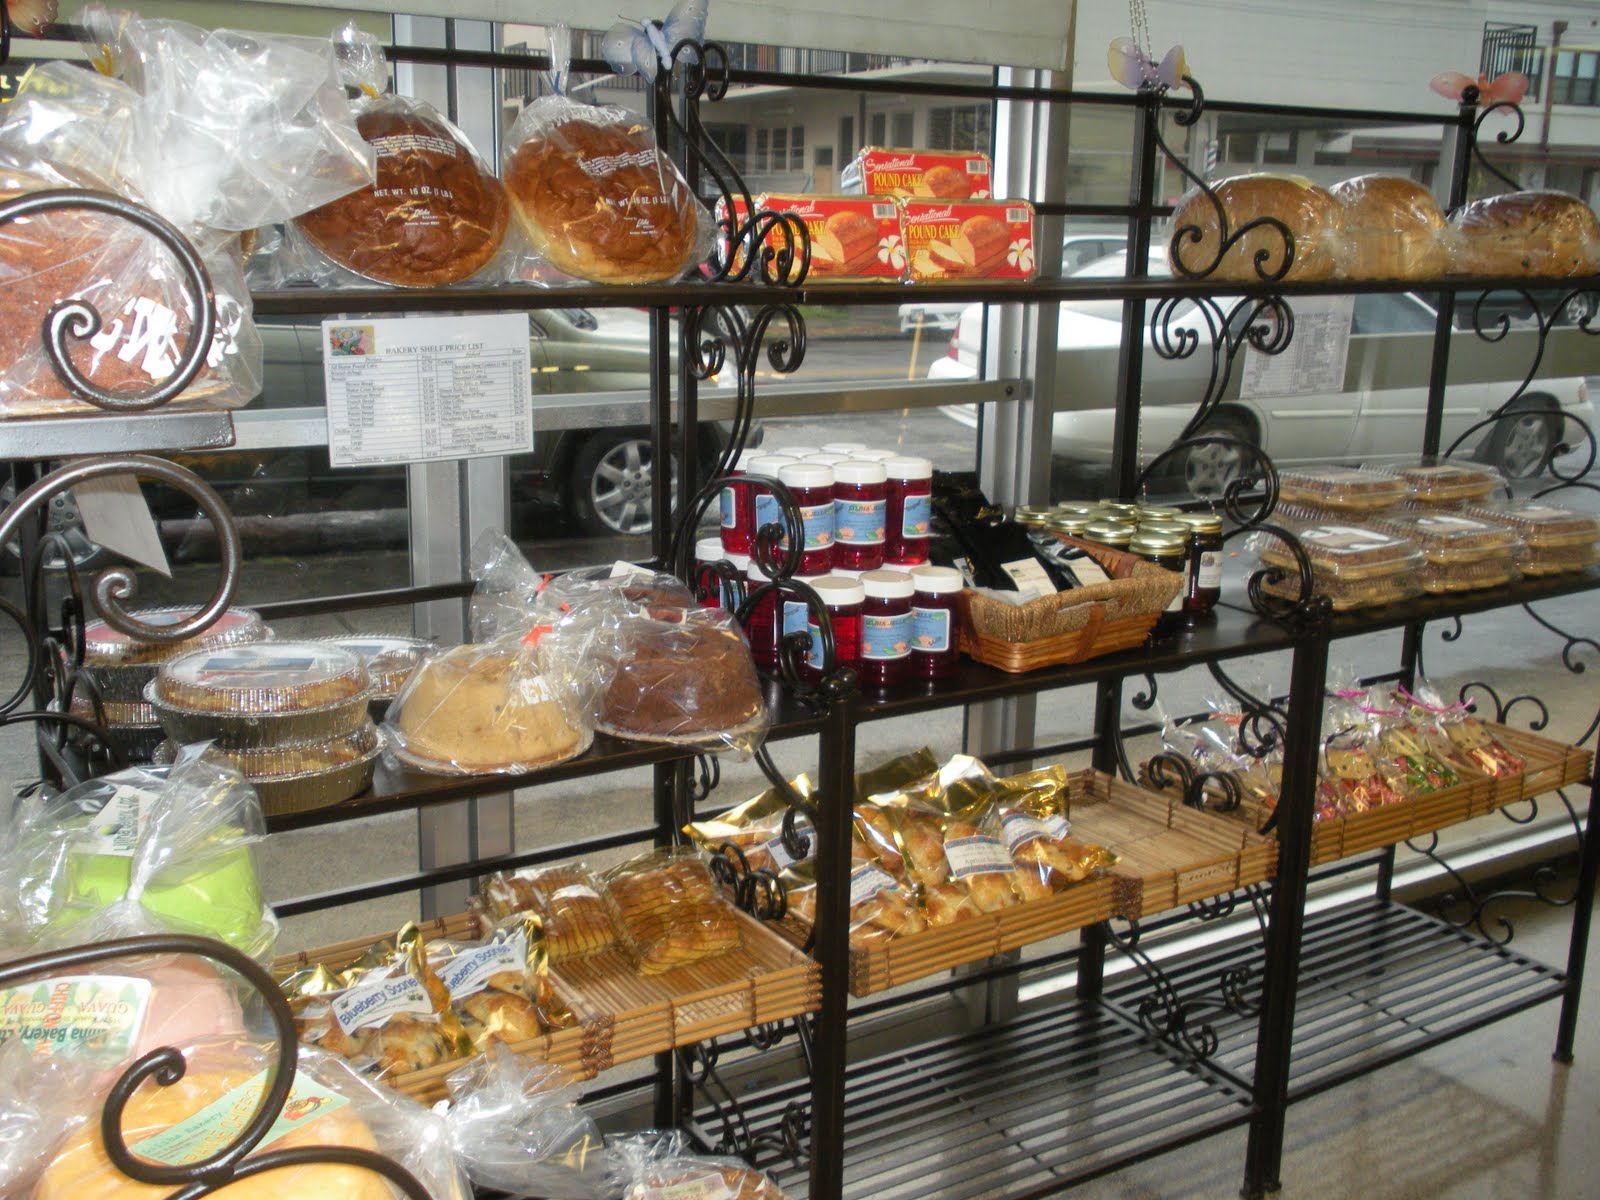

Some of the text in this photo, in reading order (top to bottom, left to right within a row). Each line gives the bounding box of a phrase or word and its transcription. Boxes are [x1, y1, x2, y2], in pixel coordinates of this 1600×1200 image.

[866, 154, 915, 174] Sensational
[874, 172, 922, 187] POUND CAKE
[374, 188, 388, 197] NET
[909, 225, 960, 239] POUND CAKE
[386, 342, 484, 355] BAKERY SHELF PRICE LIST
[4, 1003, 47, 1015] GUAVA
[80, 1001, 129, 1015] GUAVA
[339, 990, 388, 1026] Blueberry
[19, 1025, 68, 1043] Bakery,
